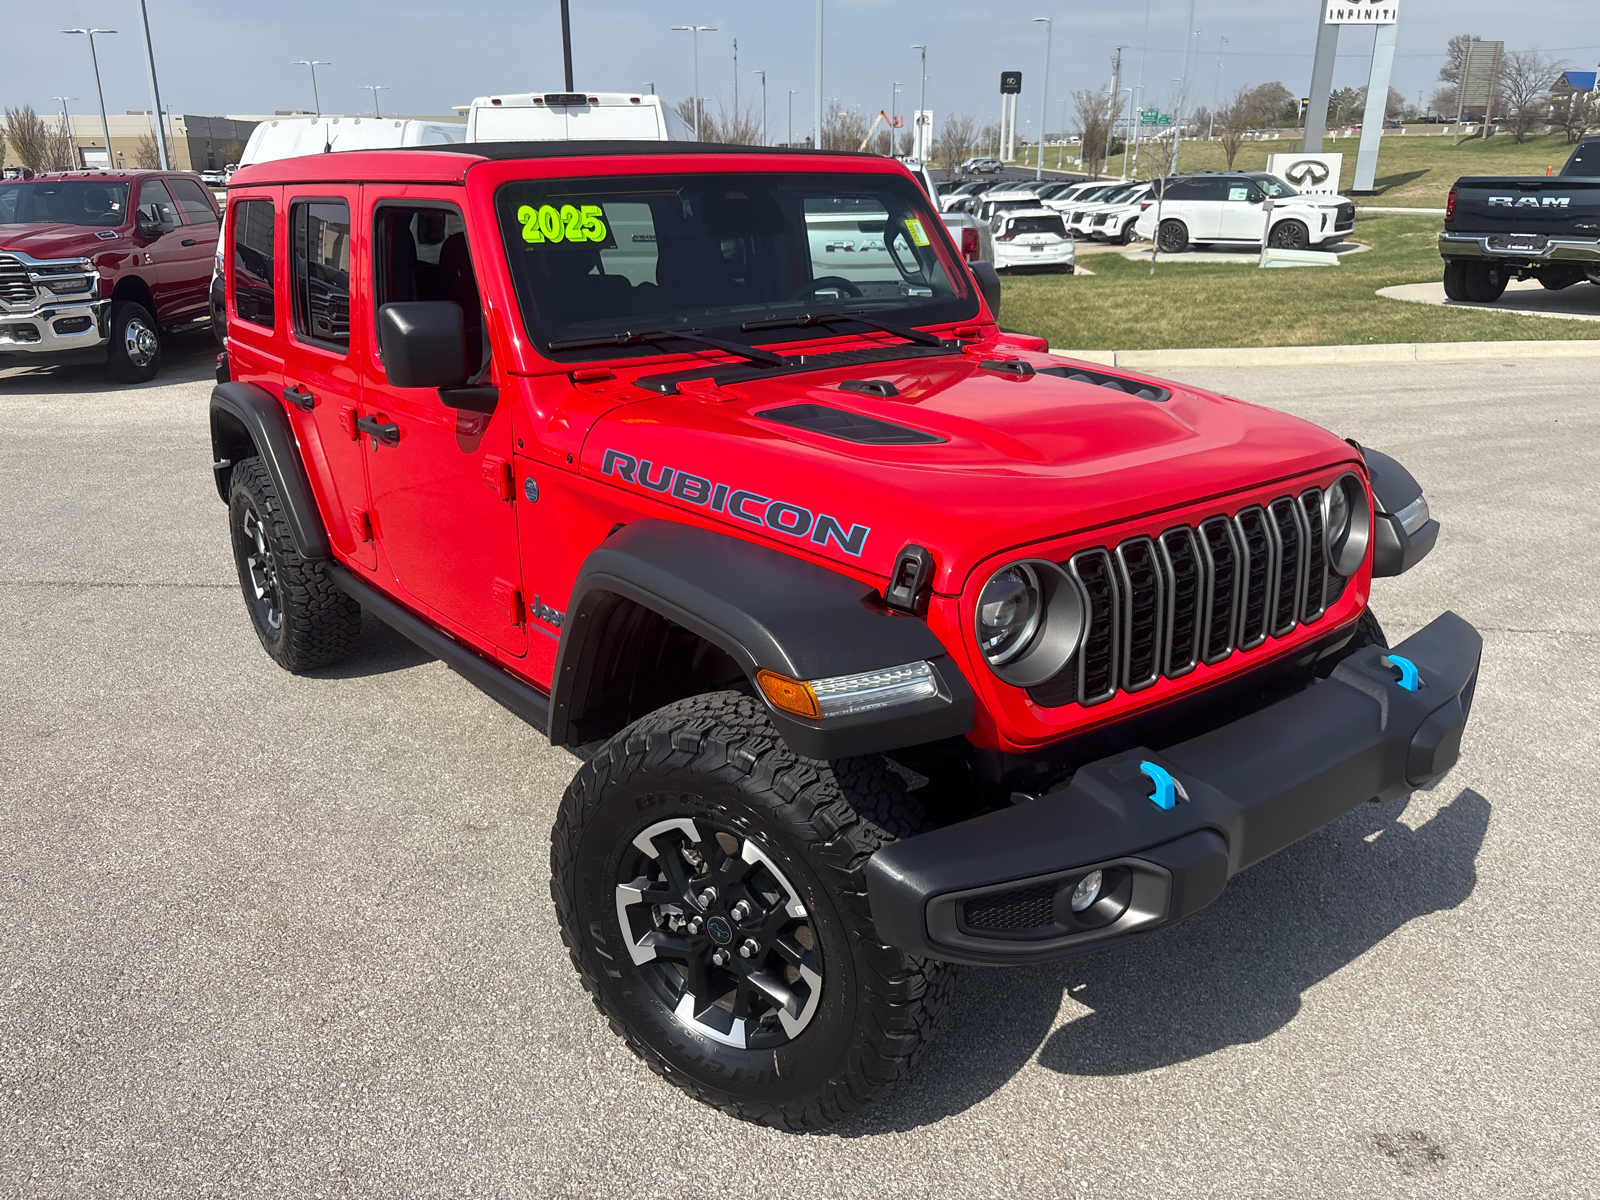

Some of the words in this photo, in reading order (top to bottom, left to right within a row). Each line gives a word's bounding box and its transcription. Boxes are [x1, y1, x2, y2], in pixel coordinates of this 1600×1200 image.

[1329, 9, 1396, 20] INFINITI
[1488, 196, 1571, 208] RAM
[517, 204, 607, 243] 2025
[601, 448, 871, 557] RUBICON
